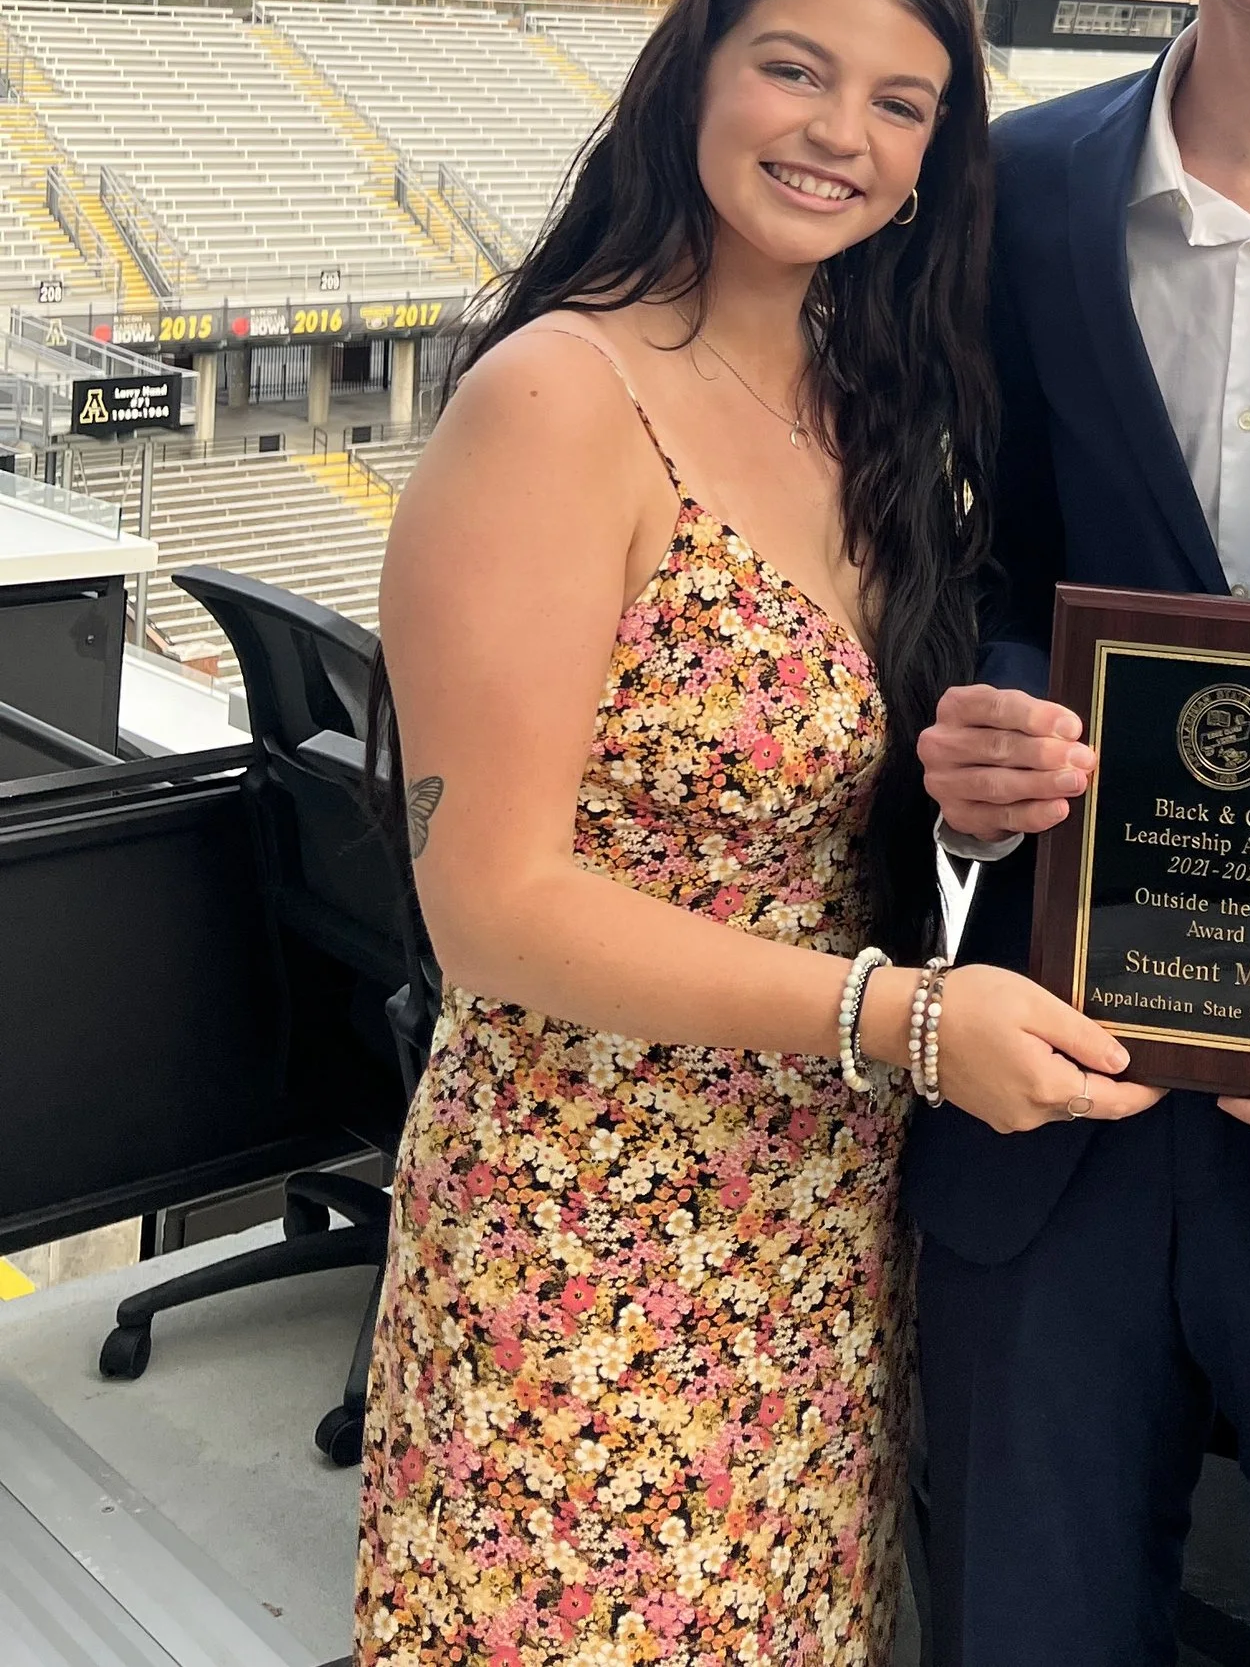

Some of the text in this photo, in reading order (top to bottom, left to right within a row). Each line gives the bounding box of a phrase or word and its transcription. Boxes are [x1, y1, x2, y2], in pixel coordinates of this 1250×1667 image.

[41, 286, 62, 303] 208
[159, 314, 212, 341] 2015
[292, 308, 343, 334] 2016
[393, 303, 442, 328] 2017
[1155, 798, 1210, 822] Black
[1218, 805, 1236, 825] &
[1124, 822, 1232, 856] Leadership
[1135, 887, 1209, 913] Outside
[1220, 897, 1250, 917] the
[1186, 920, 1245, 943] Award
[1125, 949, 1221, 982] Student
[1090, 987, 1193, 1014] Appalachian
[1203, 1000, 1242, 1020] State
